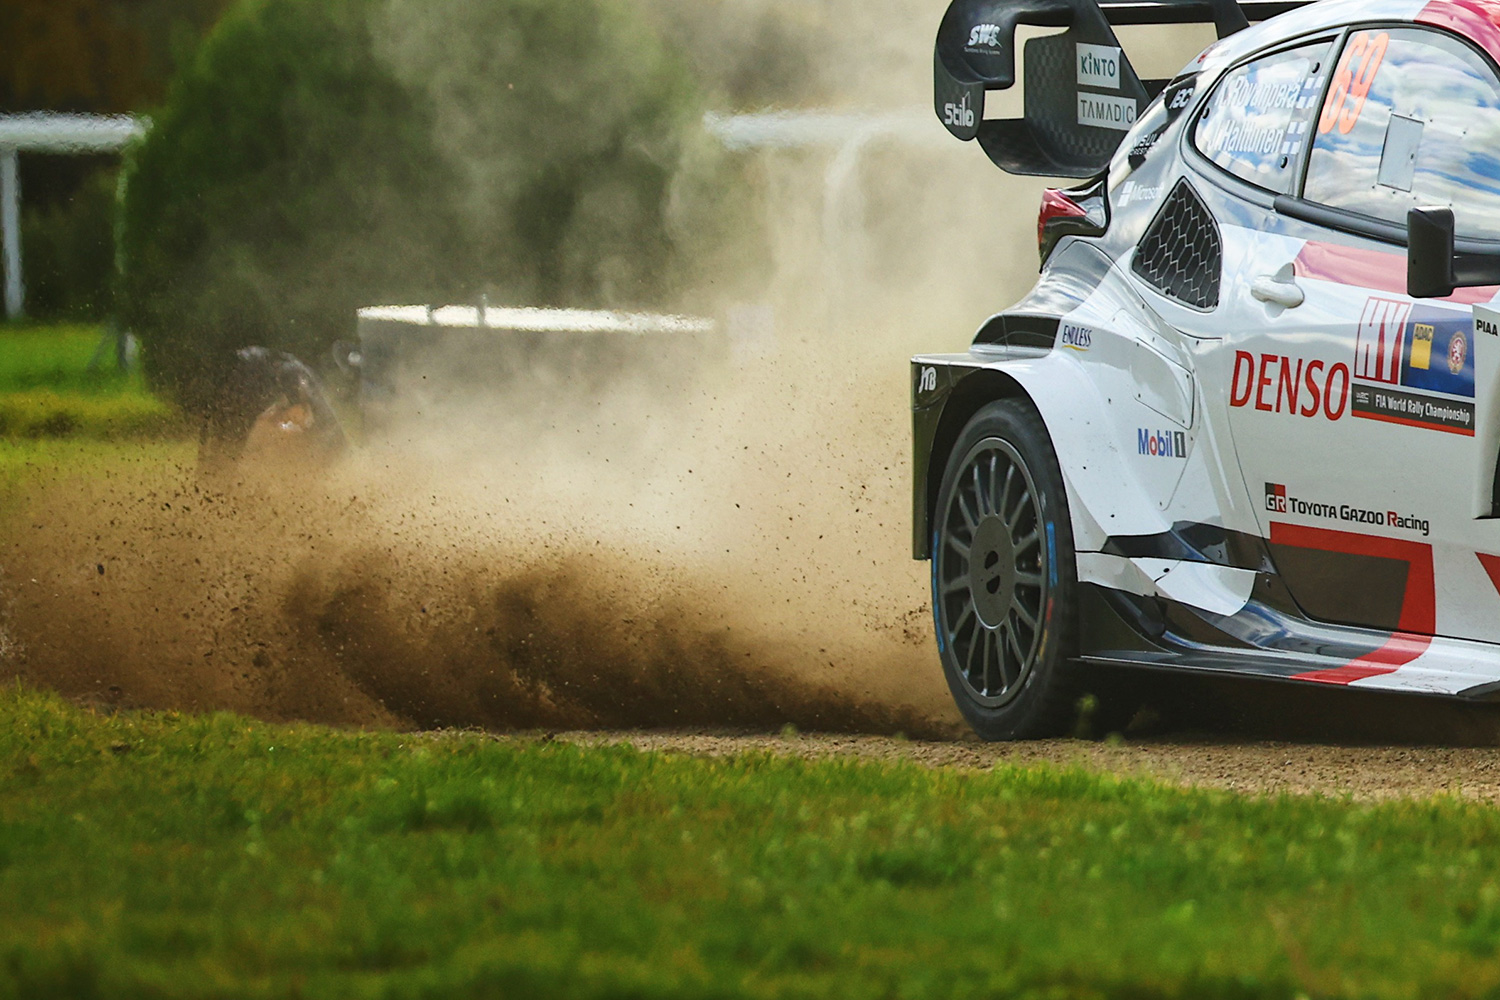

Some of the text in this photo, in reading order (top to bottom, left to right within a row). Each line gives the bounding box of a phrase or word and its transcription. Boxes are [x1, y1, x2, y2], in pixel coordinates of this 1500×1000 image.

[1319, 32, 1389, 134] 69
[1080, 99, 1134, 124] TAMADIC
[1062, 325, 1093, 348] ENDLESS
[1476, 319, 1499, 337] PIAA
[1230, 350, 1350, 421] DENSO
[1375, 394, 1471, 425] FIA World Rally Championship
[1137, 428, 1187, 459] Mobil 1
[1265, 494, 1430, 536] GR TOYOTA GAZOO Racing
